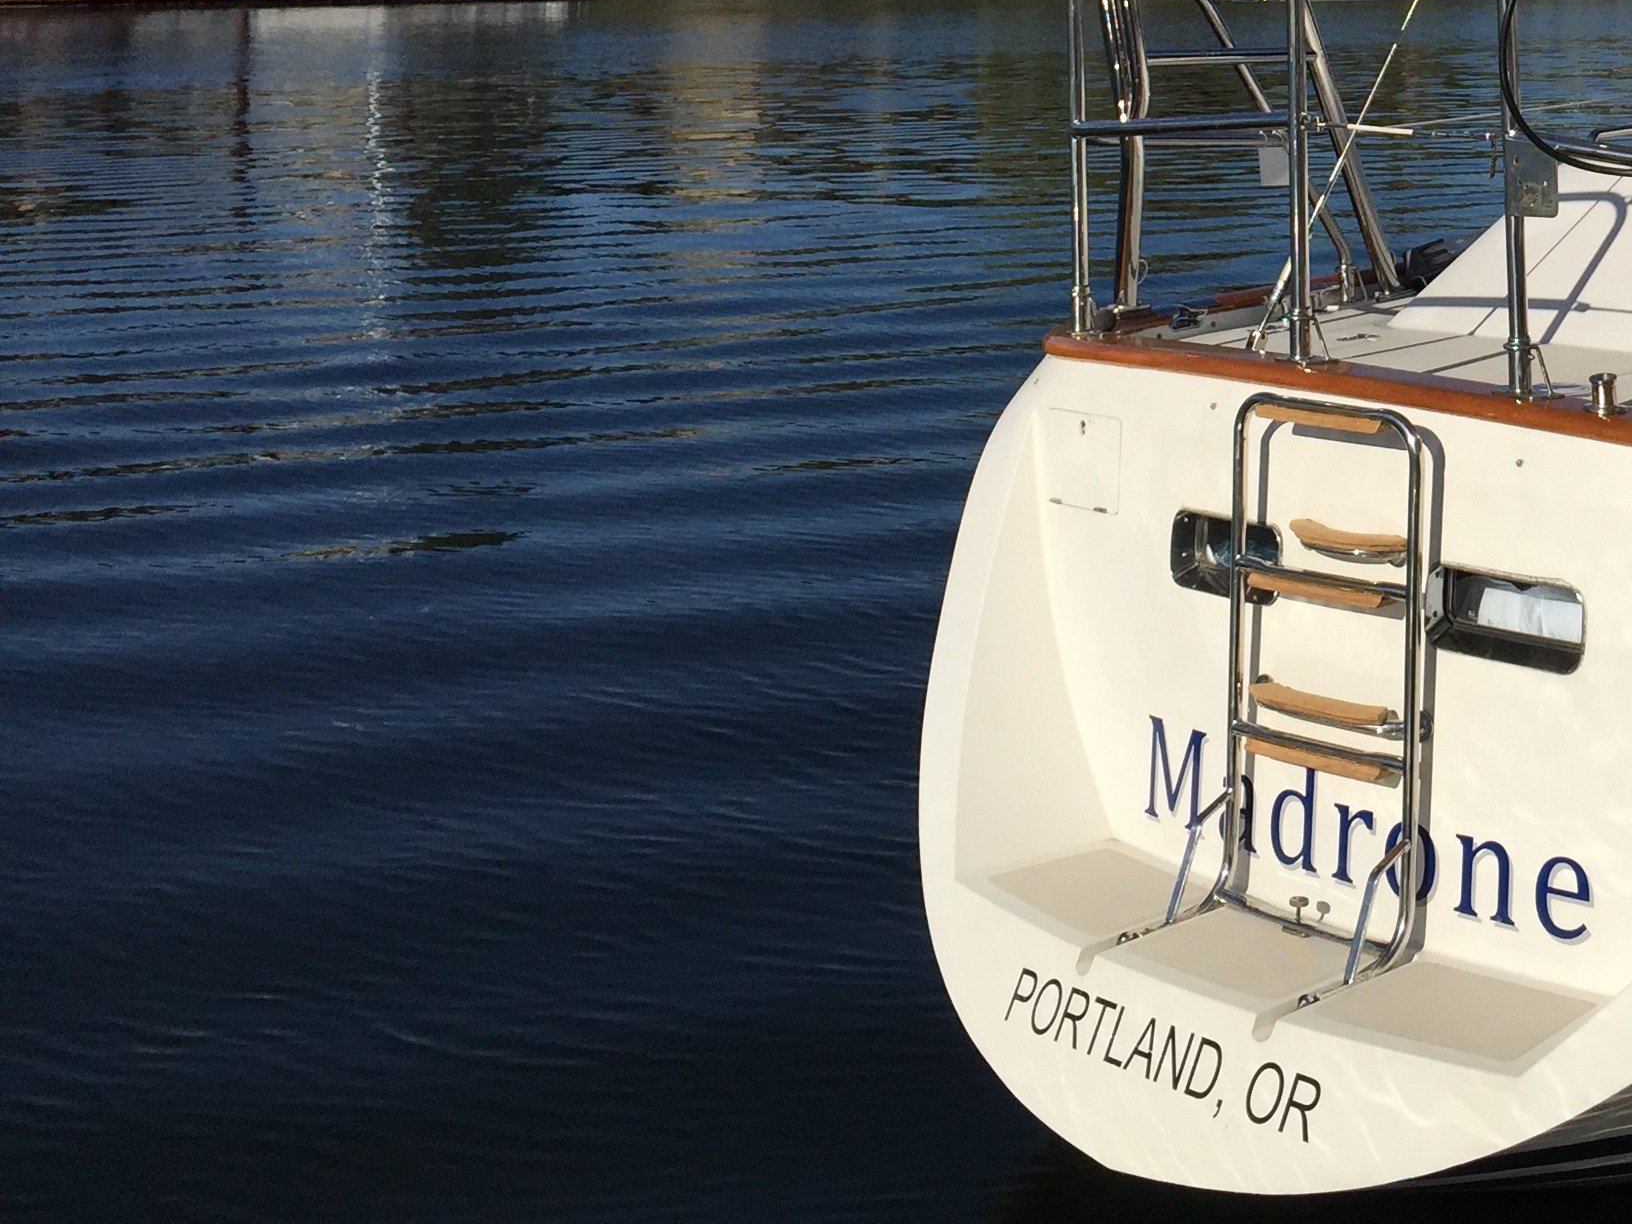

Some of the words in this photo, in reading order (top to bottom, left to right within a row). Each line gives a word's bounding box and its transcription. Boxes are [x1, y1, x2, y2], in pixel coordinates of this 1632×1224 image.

[1144, 713, 1592, 941] Madrone
[1004, 967, 1223, 1119] PORTLAND,
[1245, 1062, 1322, 1144] OR
